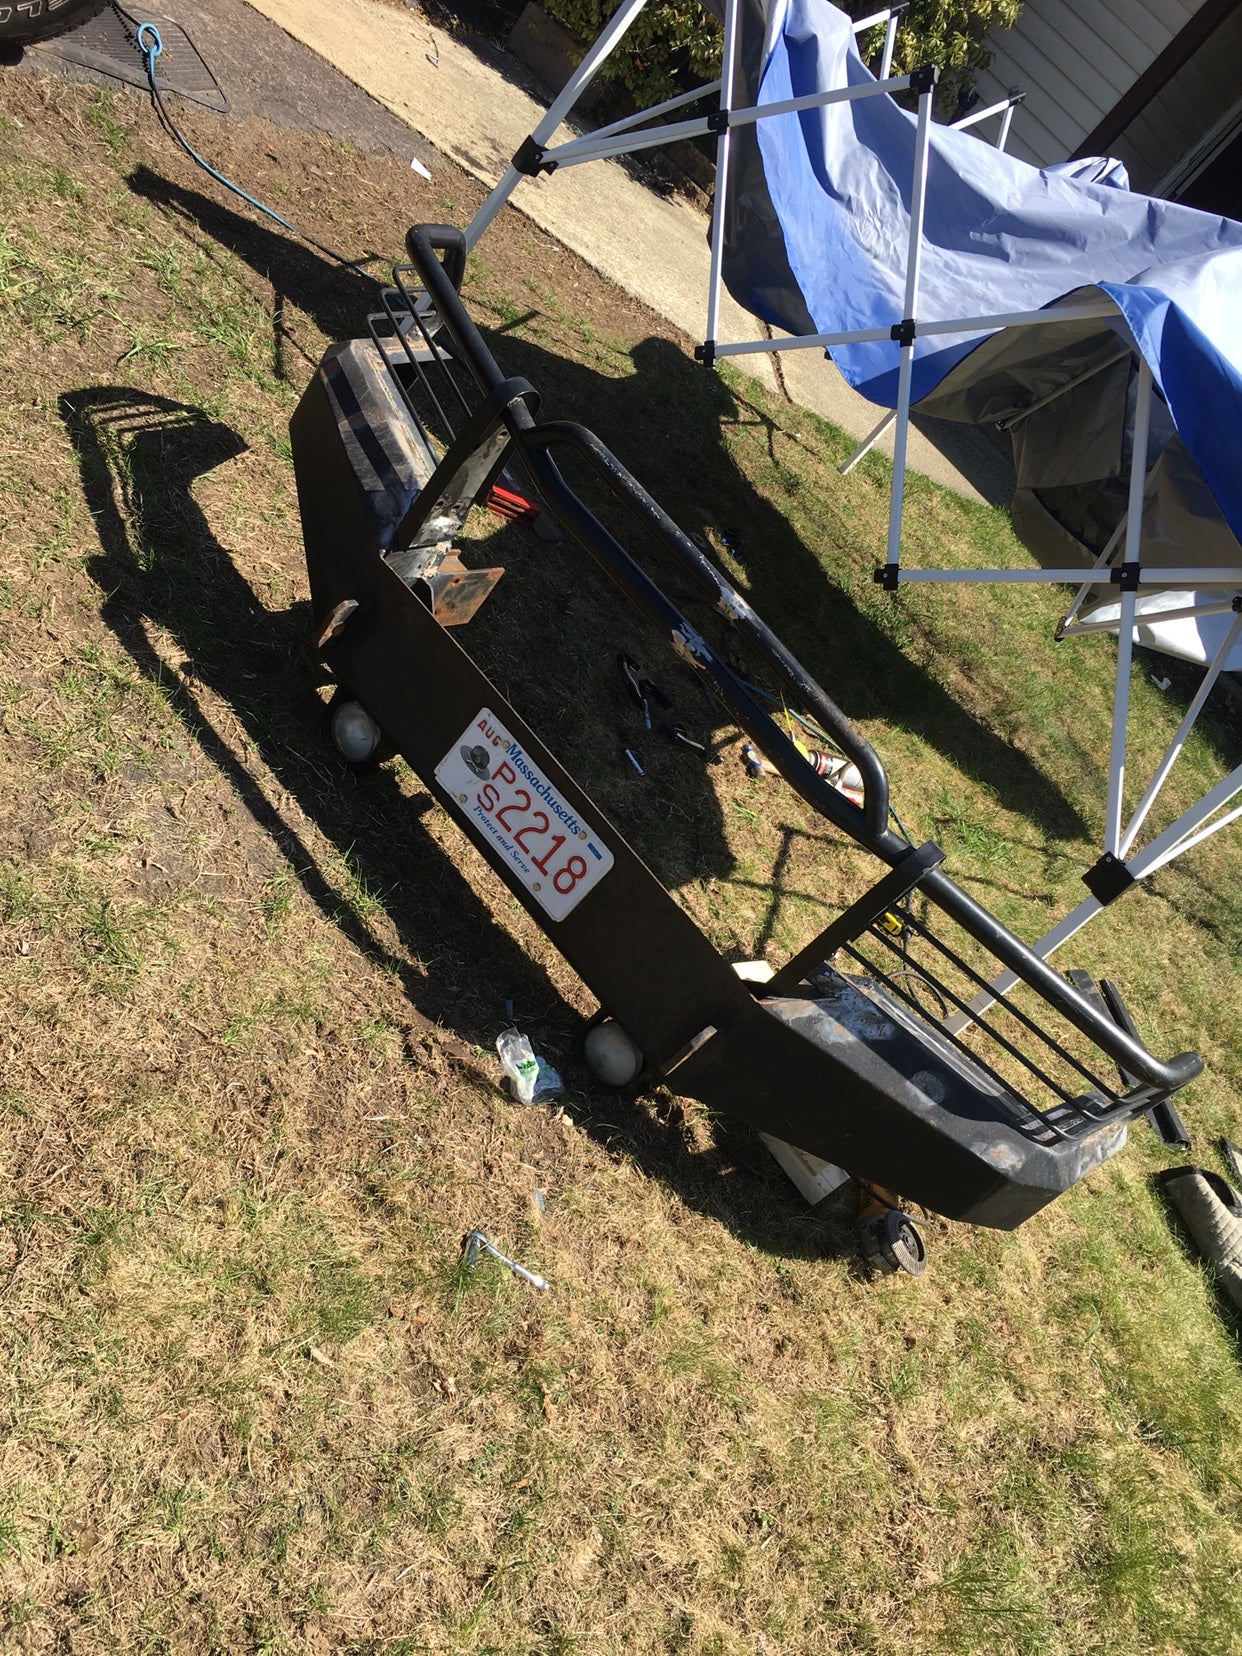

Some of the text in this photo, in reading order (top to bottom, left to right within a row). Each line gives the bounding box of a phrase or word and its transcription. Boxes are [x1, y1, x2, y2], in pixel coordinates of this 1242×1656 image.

[477, 719, 501, 747] AUG
[506, 743, 581, 835] Massachusetts
[473, 805, 530, 874] Protect and Serve
